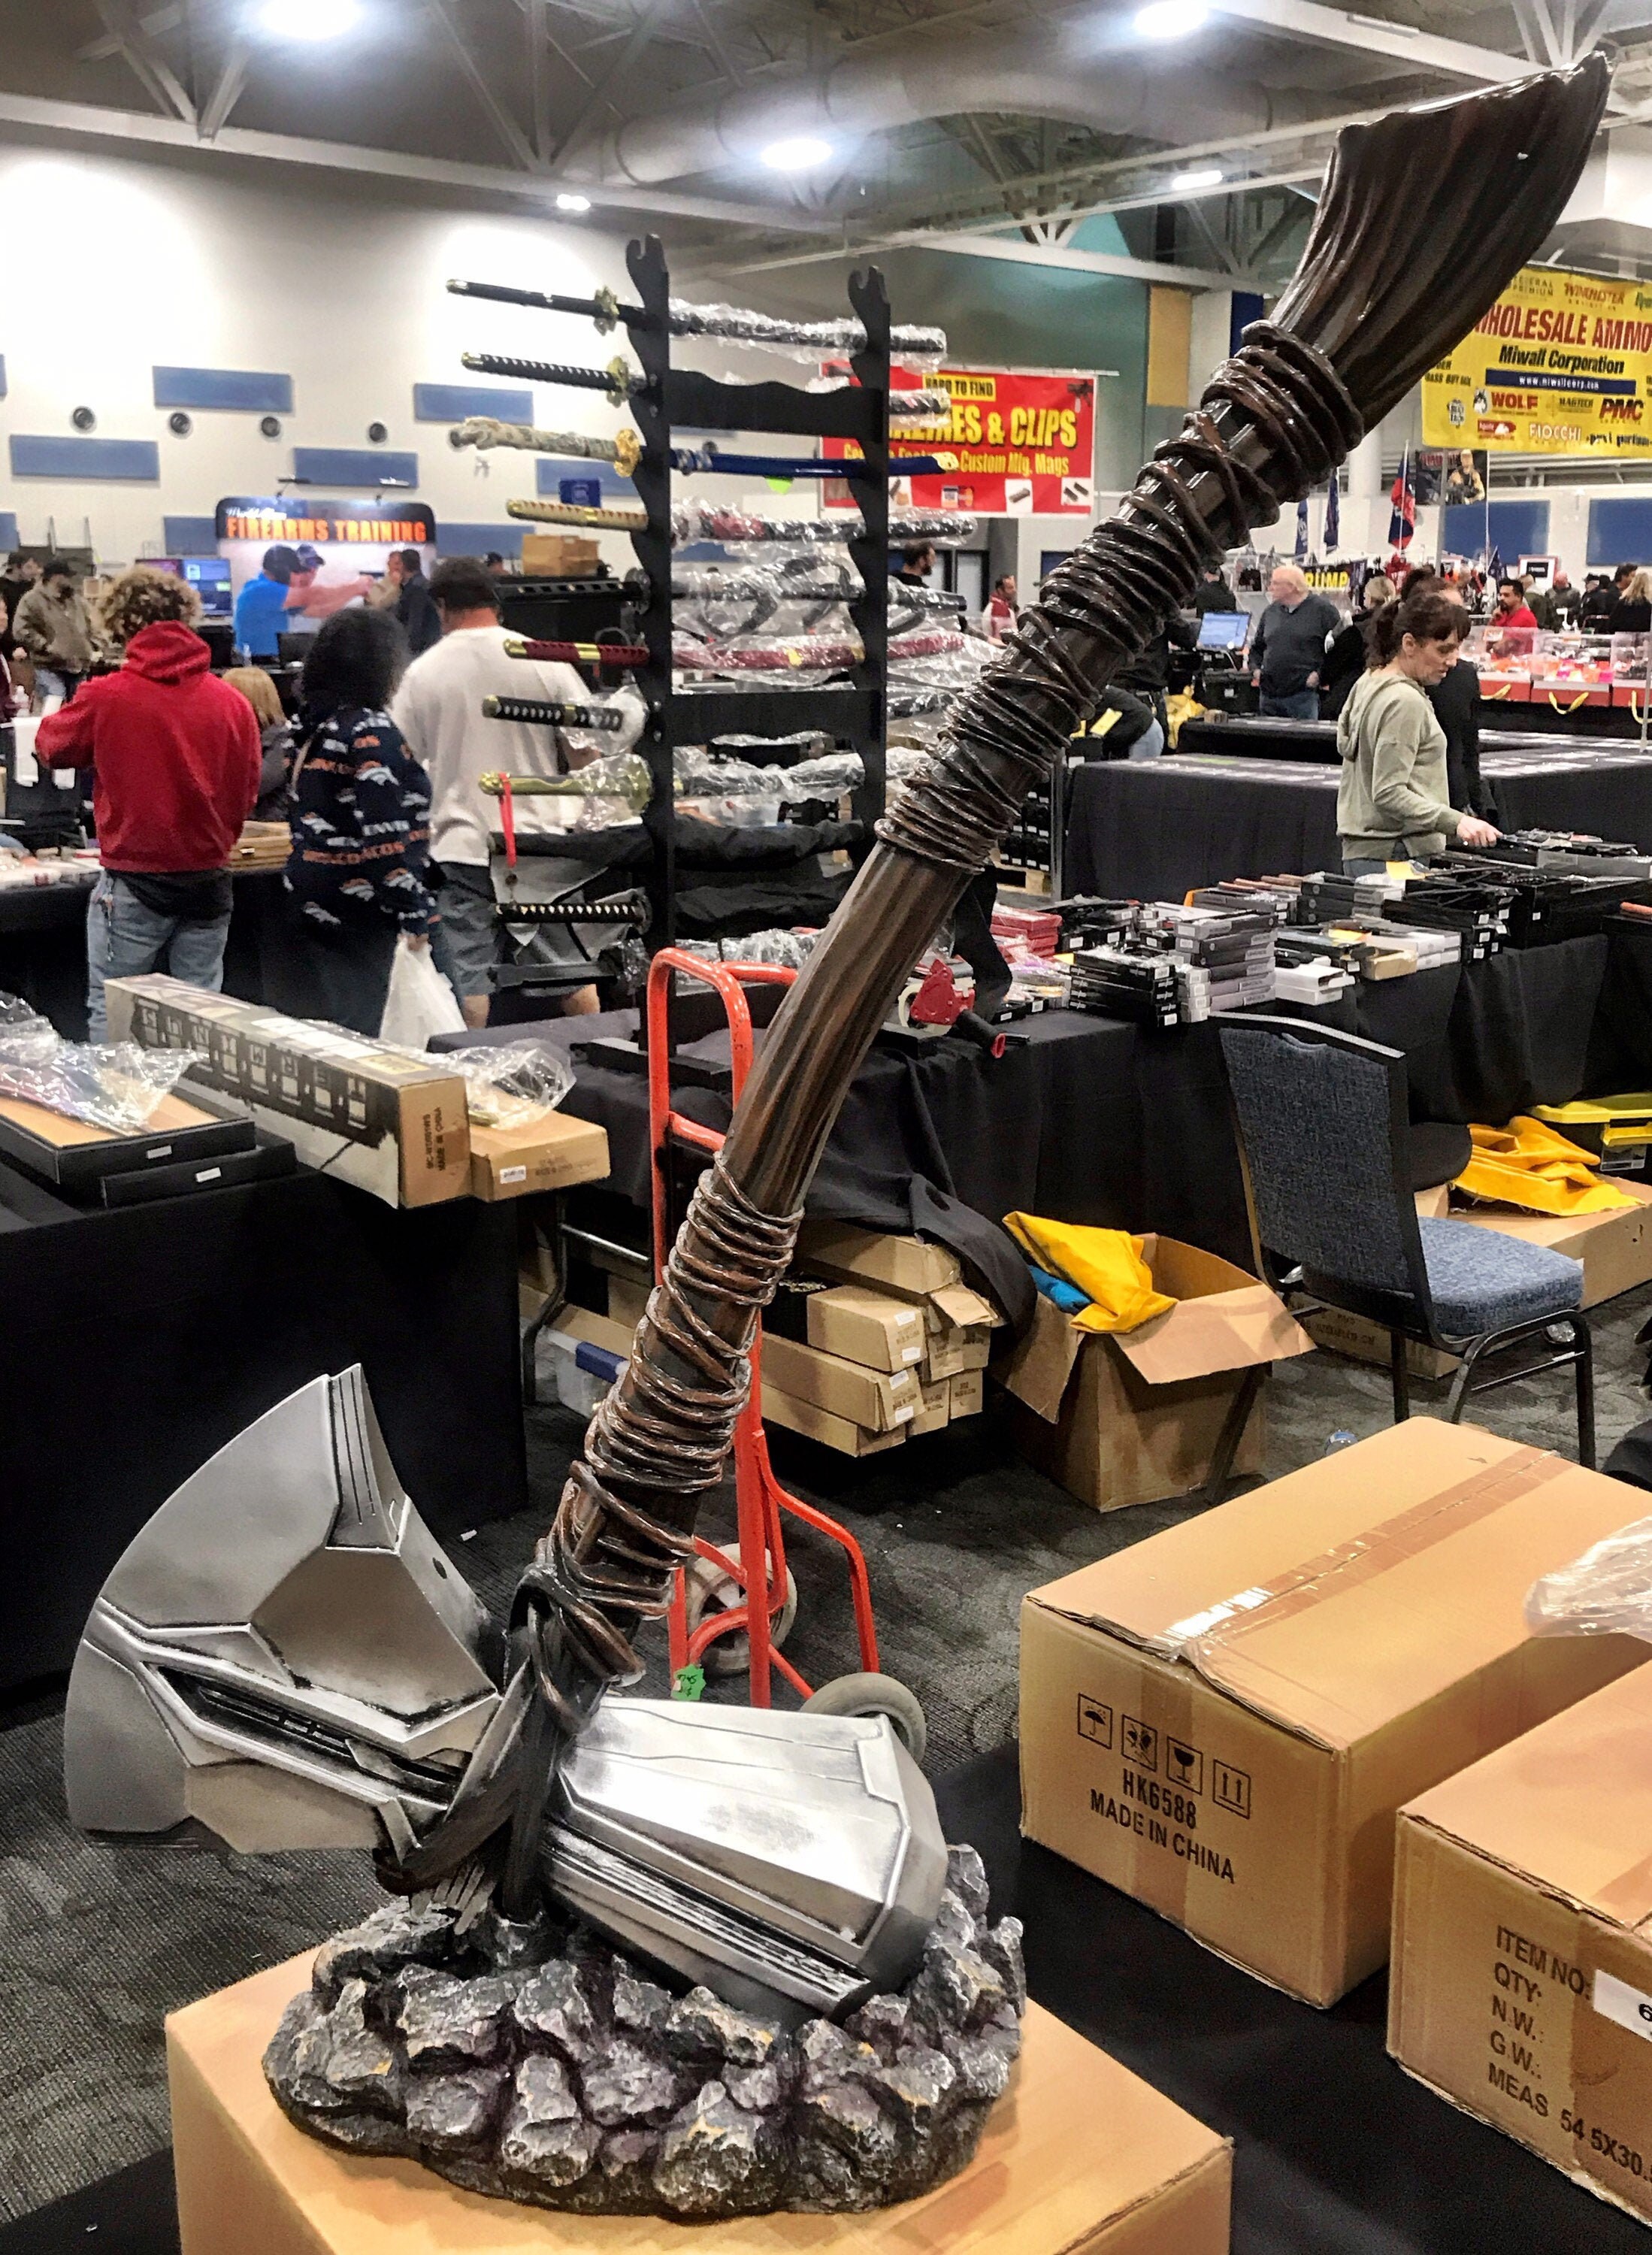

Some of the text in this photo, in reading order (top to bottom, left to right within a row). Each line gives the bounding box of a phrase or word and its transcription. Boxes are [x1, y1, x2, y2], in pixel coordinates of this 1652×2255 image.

[1592, 316, 1652, 353] AMMO
[1499, 344, 1625, 374] Miwall Corporation
[955, 380, 967, 396] TO
[970, 381, 994, 397] FIND
[1490, 391, 1539, 410] WOLF
[1599, 397, 1644, 421] PMC
[987, 411, 1006, 446] &
[1010, 407, 1077, 449] CLIPS
[1529, 423, 1581, 442] FIOCCHI
[961, 449, 1006, 474] Custom
[1035, 453, 1070, 478] Mags
[227, 516, 426, 542] FIREARMS TRAINING
[1306, 571, 1349, 589] RUMP
[1122, 1768, 1197, 1830] HK6588
[1090, 1788, 1235, 1884] MADE IN CHINA
[1496, 1925, 1590, 2001] ITEM NO:
[1494, 1962, 1542, 2007] QTY:
[1488, 2062, 1548, 2117] MEAS
